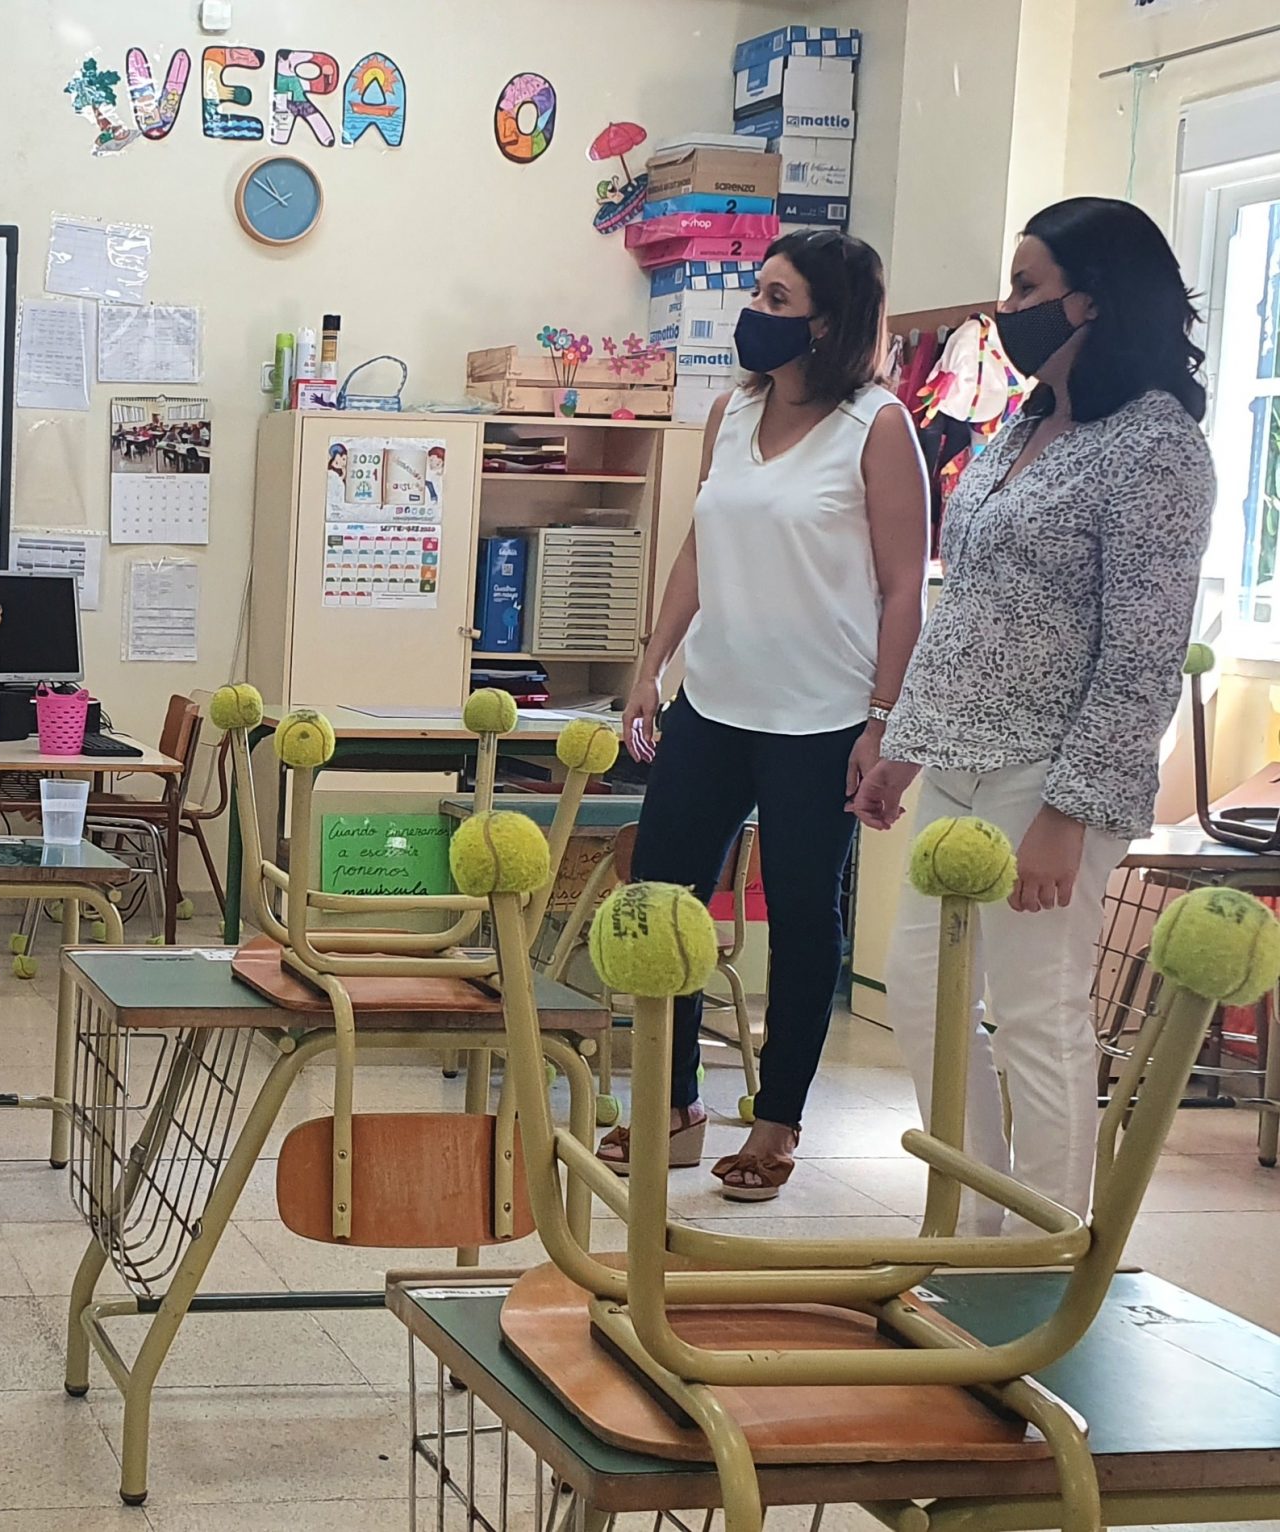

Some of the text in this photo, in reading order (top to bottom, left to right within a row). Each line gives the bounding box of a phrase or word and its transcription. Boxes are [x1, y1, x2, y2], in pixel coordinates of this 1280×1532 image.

[125, 45, 407, 147] VERA
[800, 114, 850, 129] mattio
[785, 206, 797, 215] A4
[730, 240, 742, 256] 2
[352, 454, 381, 465] 2020
[350, 468, 378, 481] 2021
[328, 819, 378, 840] Cuando
[338, 848, 348, 857] a
[333, 864, 409, 887] ponemos
